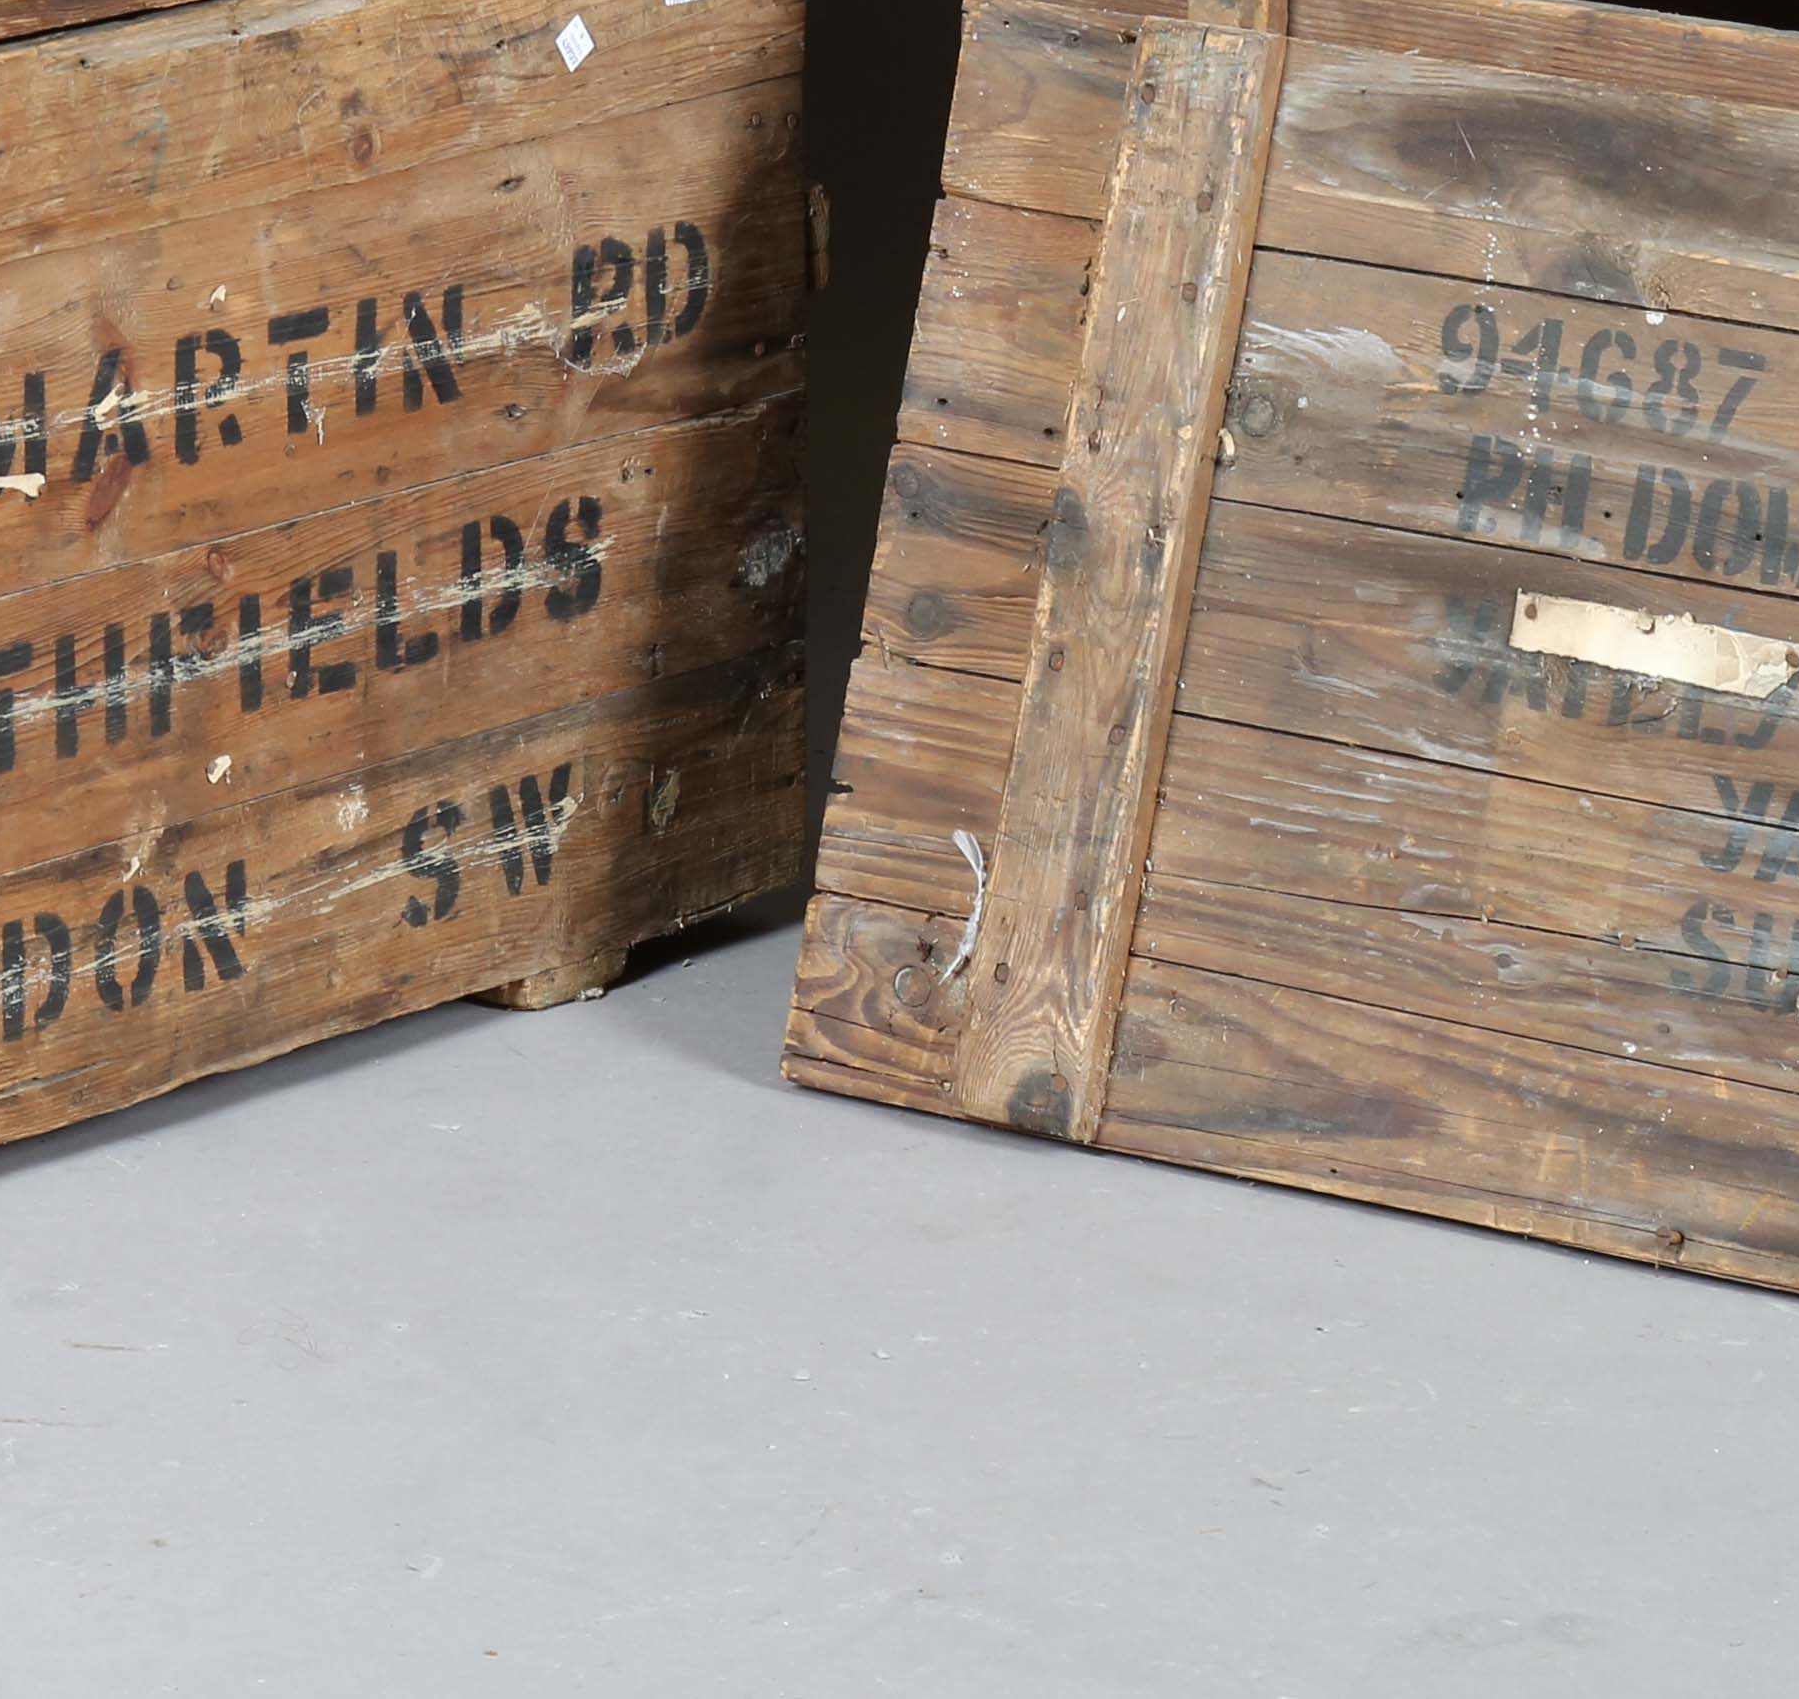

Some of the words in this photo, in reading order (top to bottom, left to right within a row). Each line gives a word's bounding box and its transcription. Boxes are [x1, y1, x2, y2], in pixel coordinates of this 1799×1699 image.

[570, 220, 709, 364] RD
[1438, 303, 1767, 444] 94687
[401, 762, 573, 929] SW
